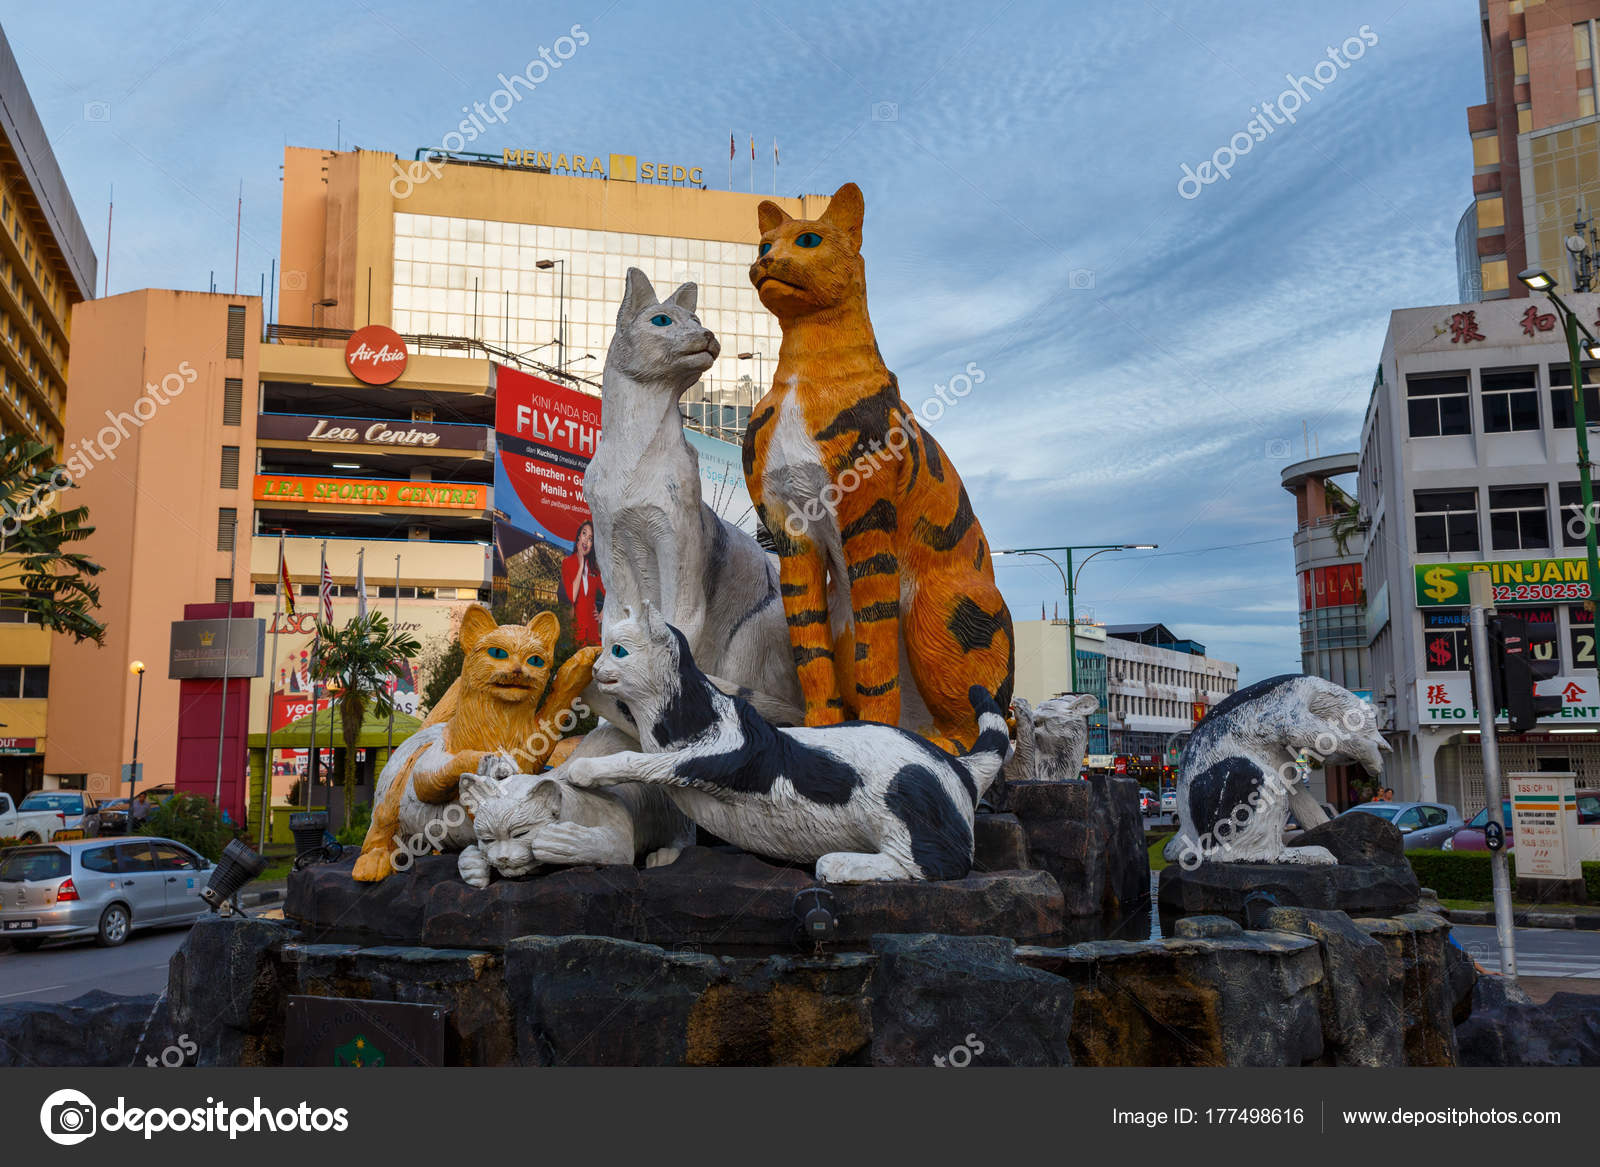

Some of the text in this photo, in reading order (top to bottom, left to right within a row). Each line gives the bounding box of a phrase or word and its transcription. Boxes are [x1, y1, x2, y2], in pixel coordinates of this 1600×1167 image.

[503, 147, 703, 184] MENARA SEDC
[532, 393, 551, 410] KINI
[553, 401, 580, 419] ANDA
[308, 419, 440, 447] Lea Centre
[536, 449, 559, 462] Kuching
[525, 461, 565, 482] Shenzhen
[263, 480, 479, 505] LEA SPORTS CENTRE
[541, 482, 567, 498] Manila
[1428, 708, 1466, 719] TEO
